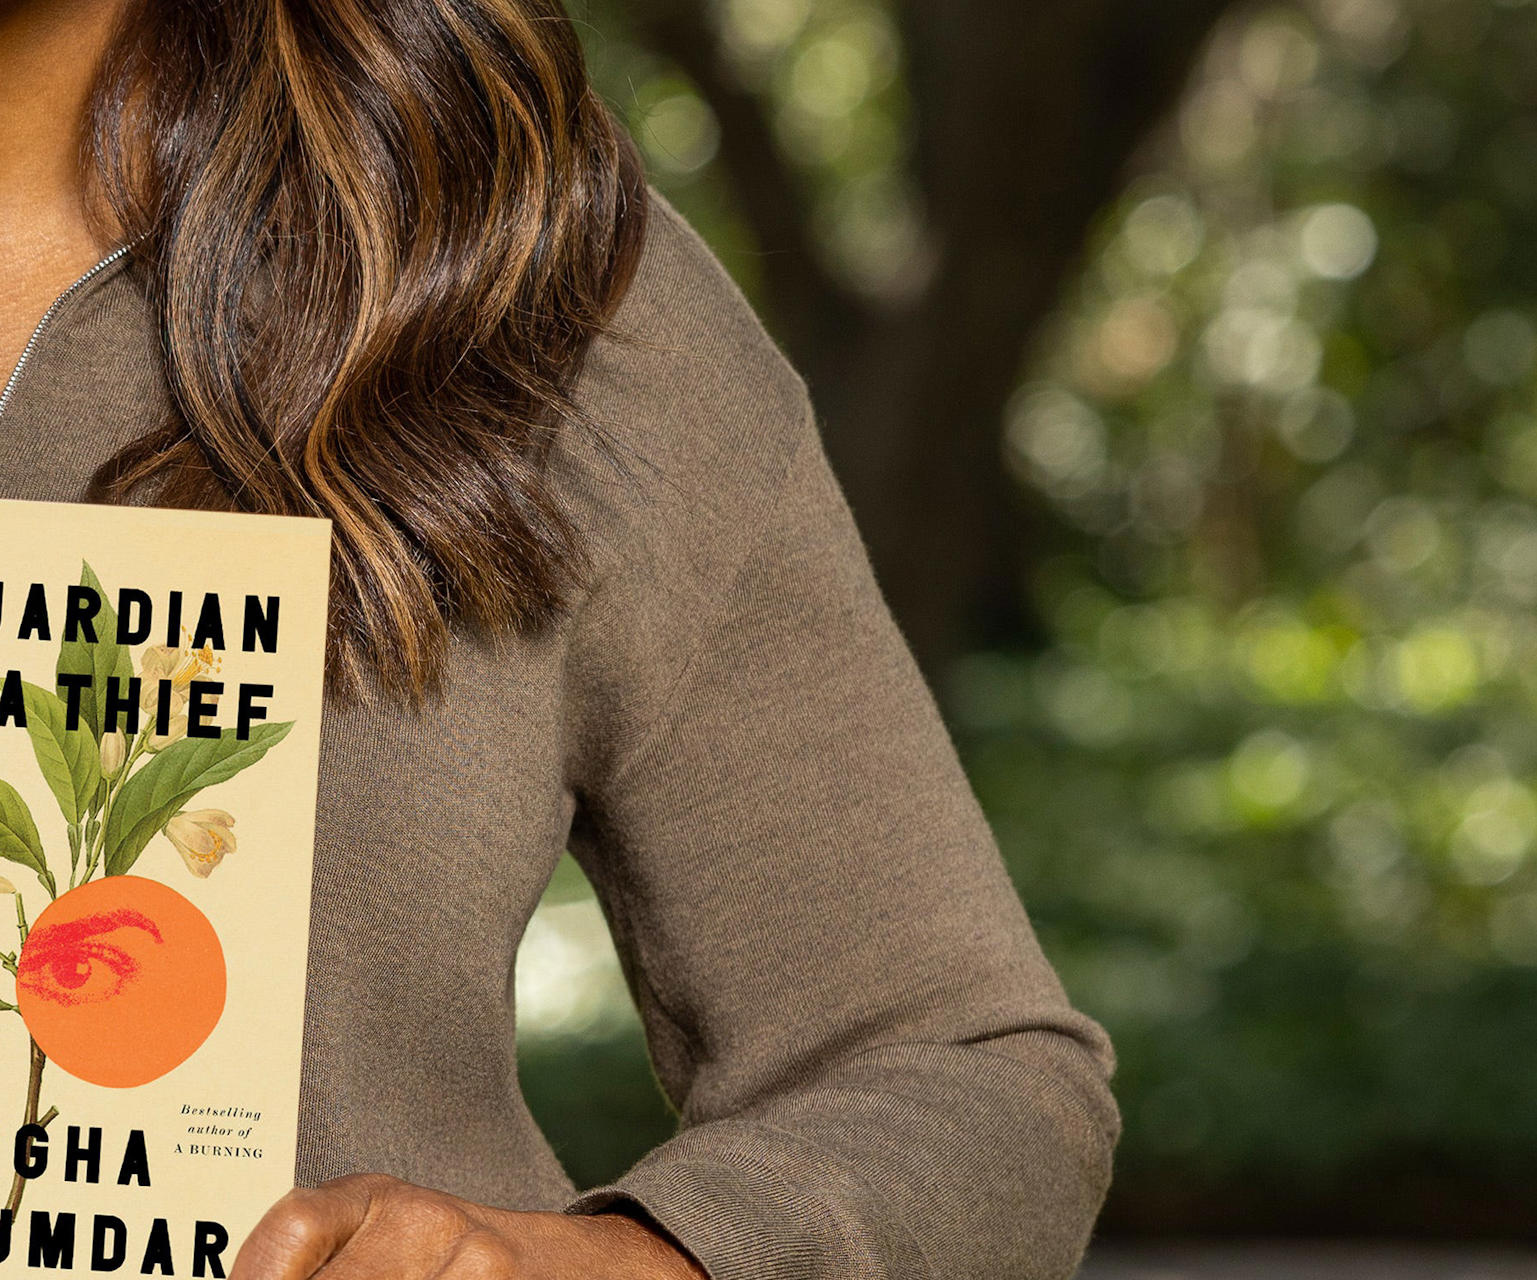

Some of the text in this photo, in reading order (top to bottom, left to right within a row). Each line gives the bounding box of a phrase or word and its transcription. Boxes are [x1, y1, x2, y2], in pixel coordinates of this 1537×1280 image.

[57, 673, 274, 741] THIEF
[181, 1104, 261, 1121] Bestselling
[187, 1125, 253, 1140] author of
[174, 1143, 263, 1159] A BURNING
